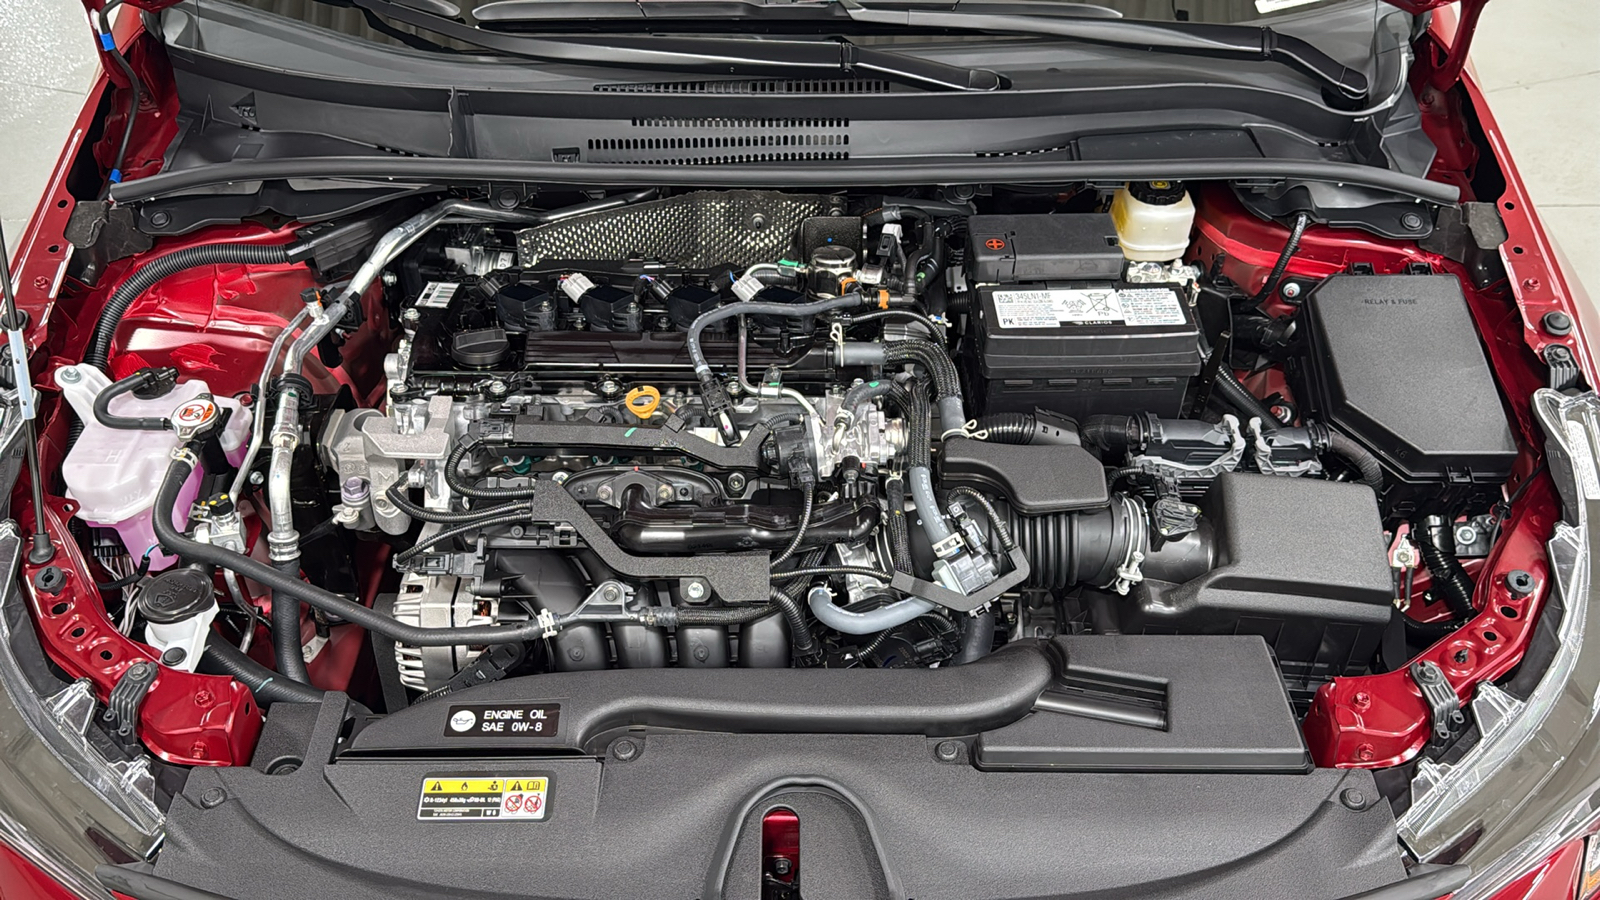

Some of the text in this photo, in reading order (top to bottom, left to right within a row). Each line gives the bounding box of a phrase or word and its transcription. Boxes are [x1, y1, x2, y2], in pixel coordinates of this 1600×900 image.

[1003, 318, 1014, 326] PK
[483, 709, 547, 720] ENGINE OIL
[481, 721, 543, 732] SAE 0W-8
